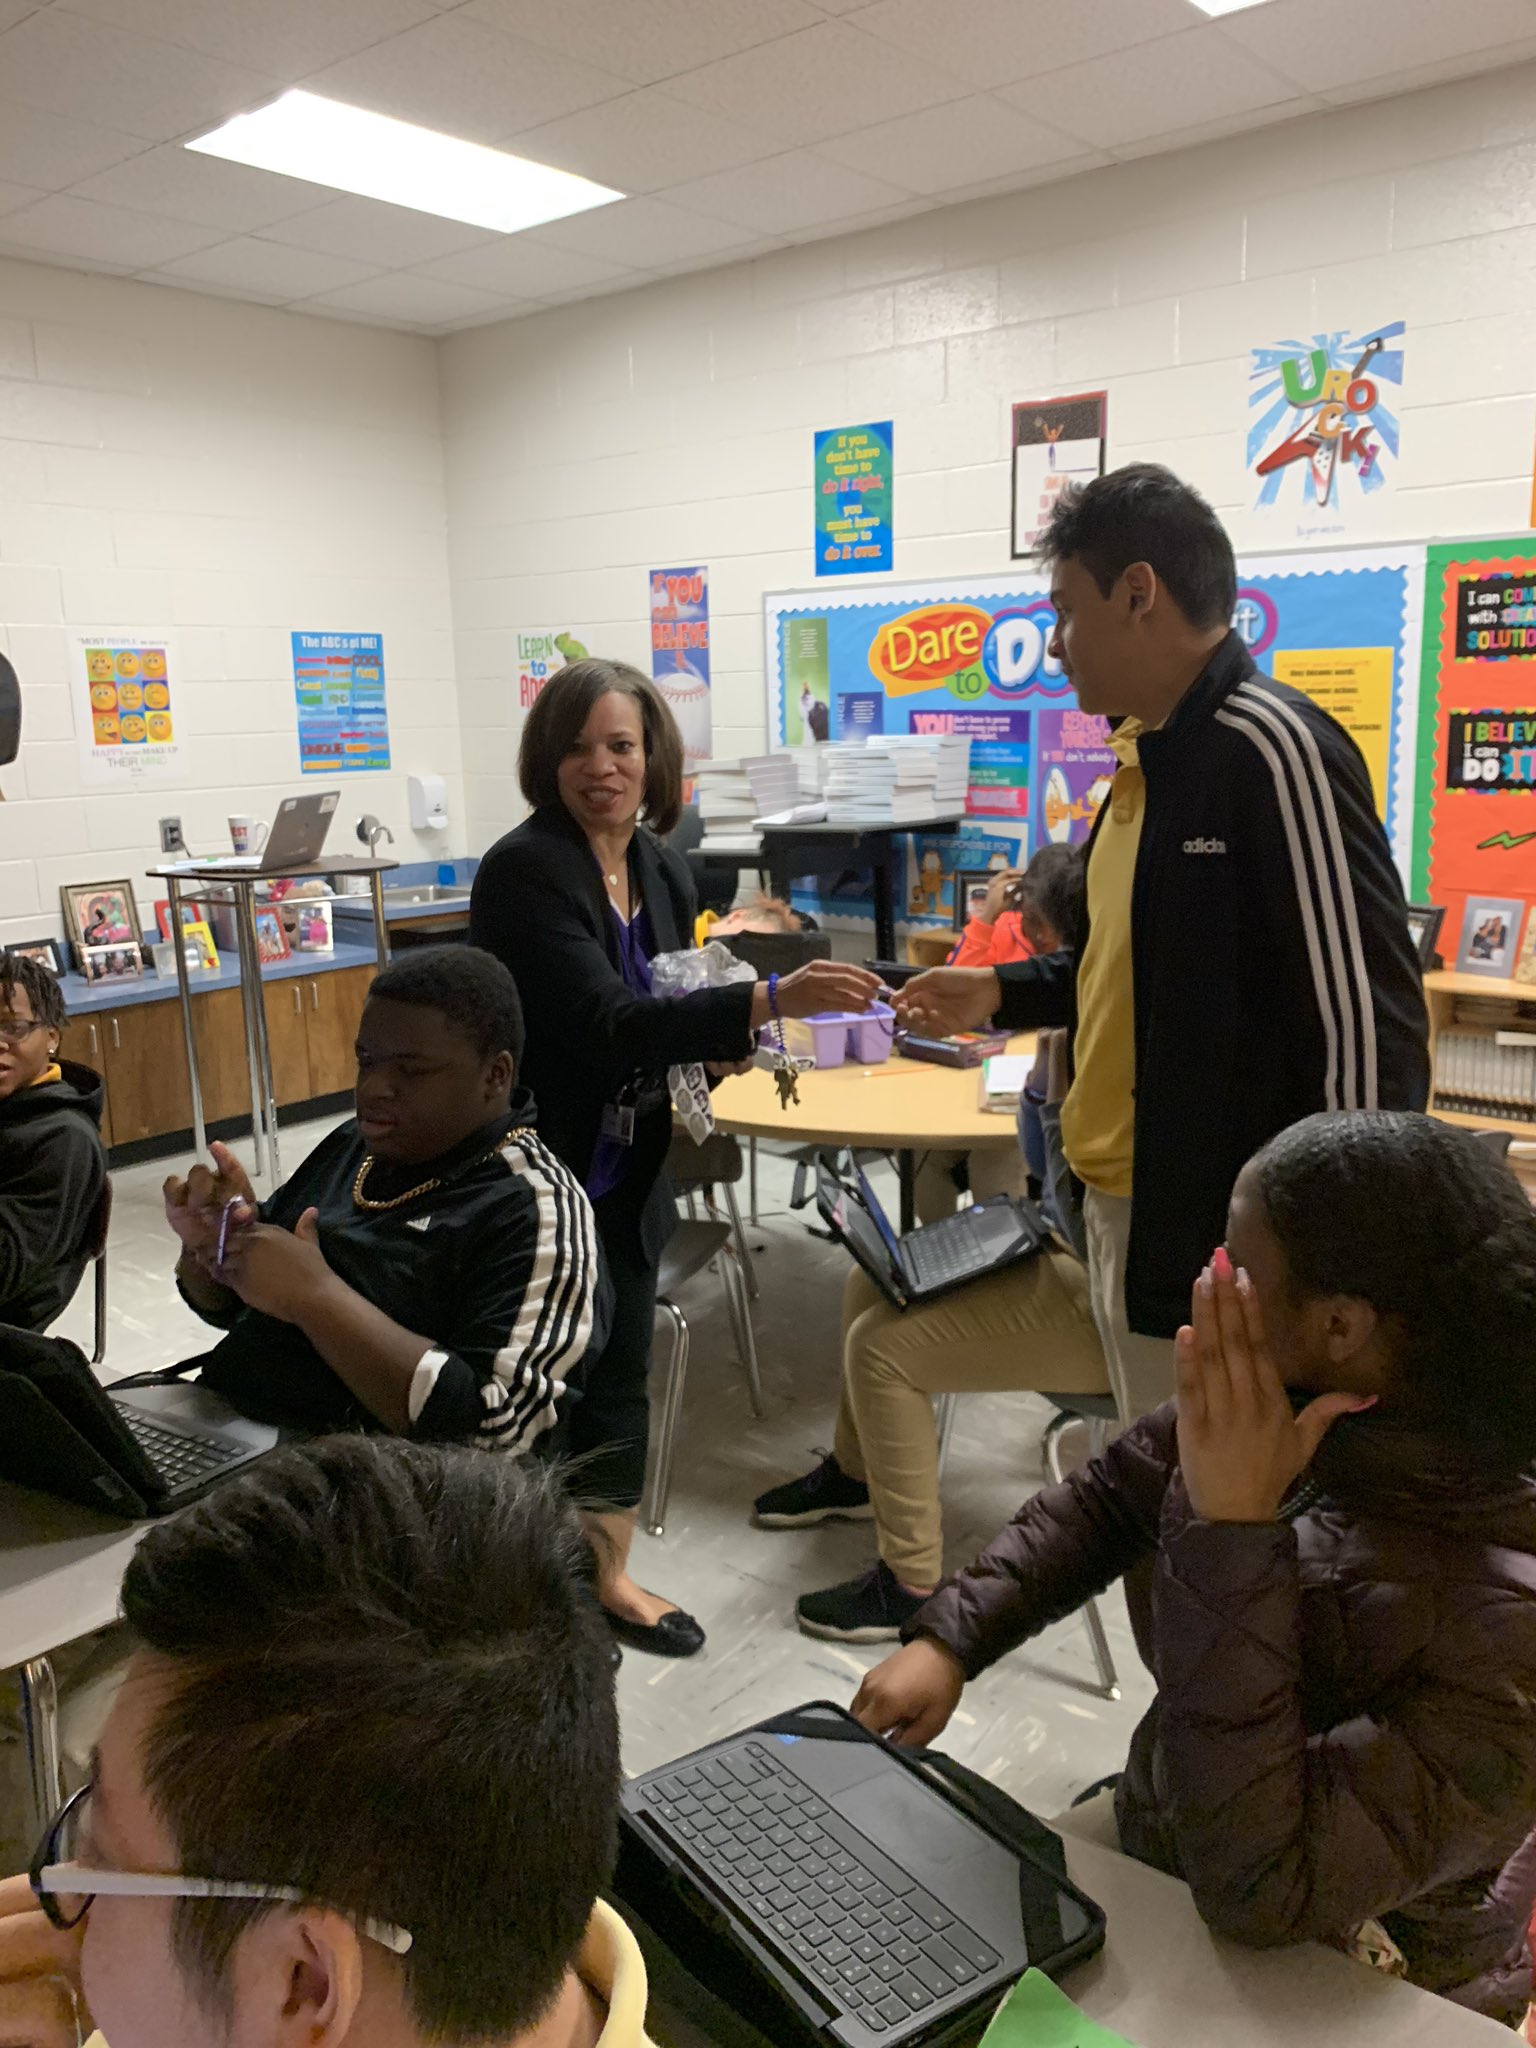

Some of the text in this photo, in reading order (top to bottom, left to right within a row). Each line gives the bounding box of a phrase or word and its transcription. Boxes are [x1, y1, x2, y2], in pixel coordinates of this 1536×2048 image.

[1280, 349, 1328, 408] U
[848, 435, 868, 448] you
[826, 448, 880, 464] don't have
[834, 462, 872, 475] time to
[822, 478, 838, 494] do
[840, 477, 849, 492] it
[843, 505, 862, 517] you
[826, 517, 880, 531] must have
[834, 531, 872, 543] time to
[824, 545, 840, 561] do
[842, 545, 851, 560] it
[667, 575, 704, 604] YOU
[1467, 586, 1536, 606] I can COM
[1467, 609, 1498, 625] with
[301, 635, 320, 648] The
[651, 622, 709, 650] BELIEVE
[518, 633, 553, 660] LEARN
[887, 620, 982, 694] Dare to
[530, 660, 547, 676] to
[1464, 721, 1536, 743] I BELIEV
[1463, 743, 1500, 758] I can
[1462, 758, 1501, 782] DO
